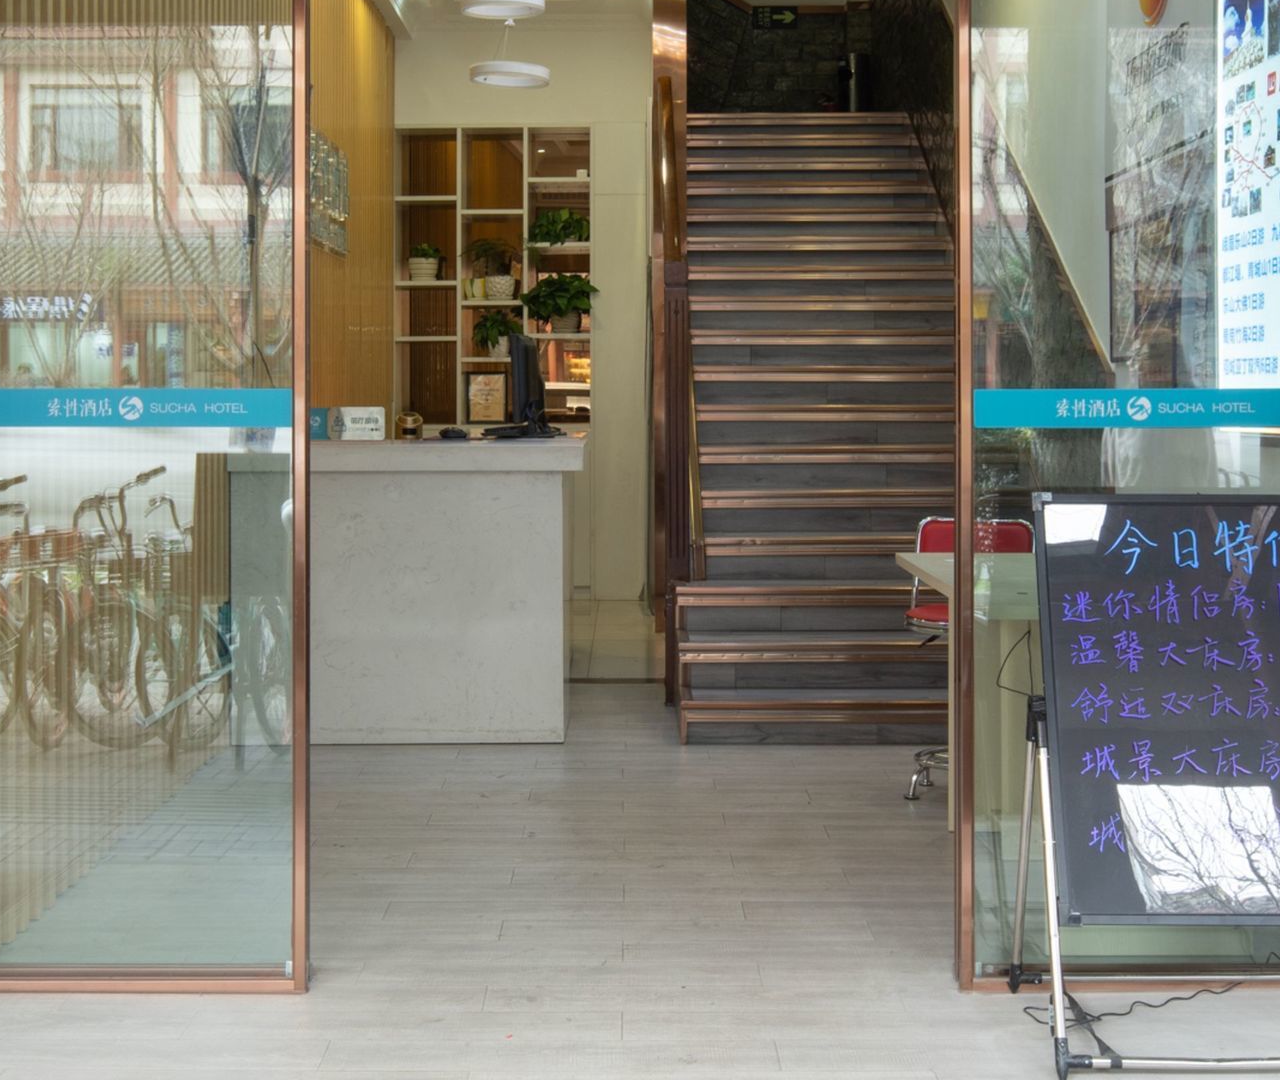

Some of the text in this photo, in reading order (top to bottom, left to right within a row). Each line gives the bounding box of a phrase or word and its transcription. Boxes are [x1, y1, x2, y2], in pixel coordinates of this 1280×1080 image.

[149, 402, 196, 414] SUCHA
[204, 402, 248, 414] HOTEL
[1158, 402, 1205, 413] SUCHA
[1212, 402, 1256, 413] HOTEL
